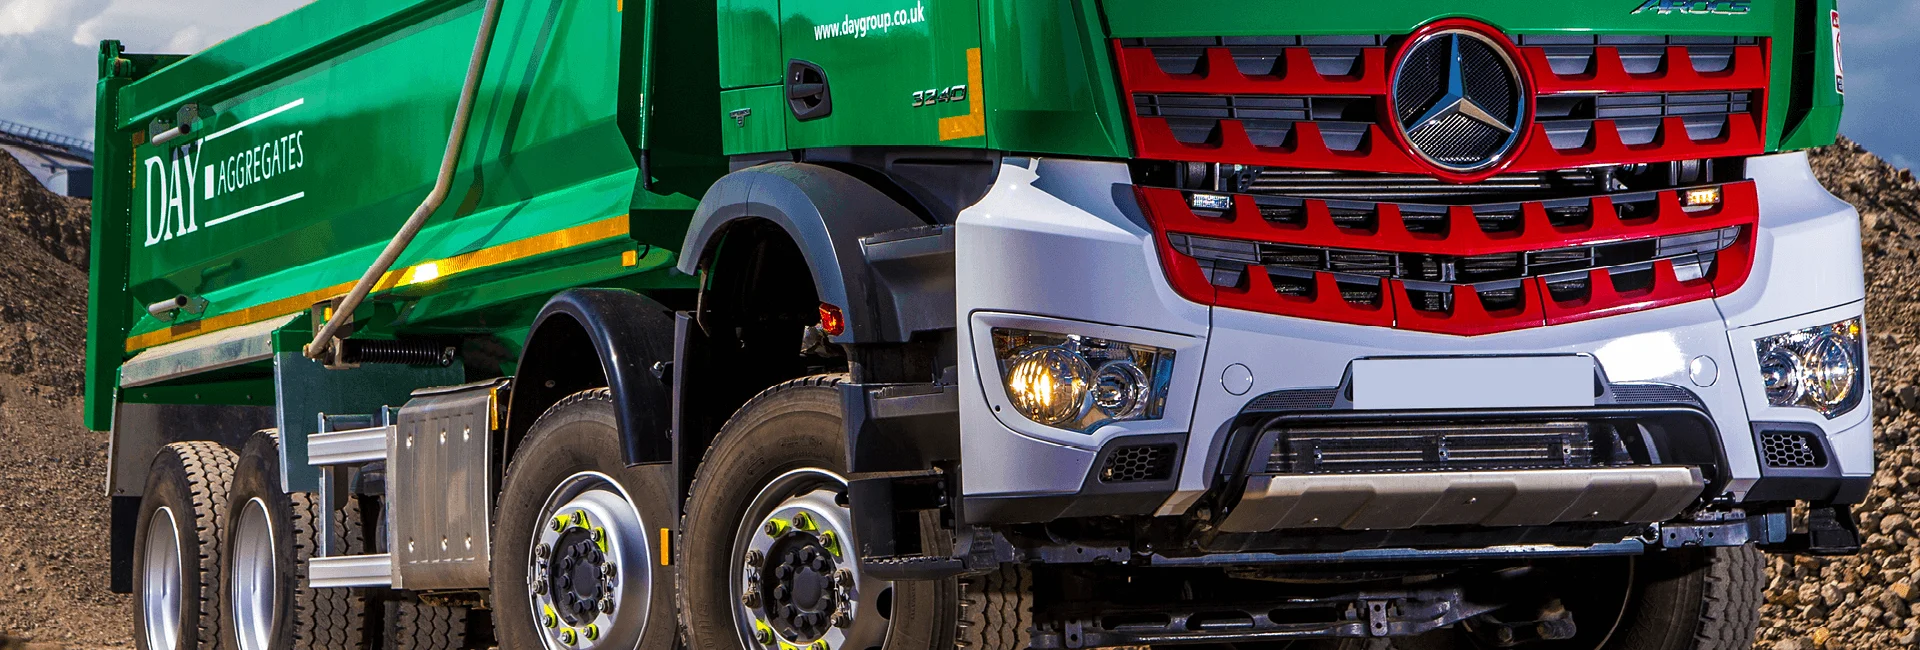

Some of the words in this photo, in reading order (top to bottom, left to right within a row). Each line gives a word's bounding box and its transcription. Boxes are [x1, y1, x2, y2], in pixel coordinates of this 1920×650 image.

[813, 0, 925, 41] www.daygroup.co.uk
[911, 84, 968, 108] 3240
[144, 137, 204, 247] DAY
[217, 130, 304, 196] AGGREGATES
